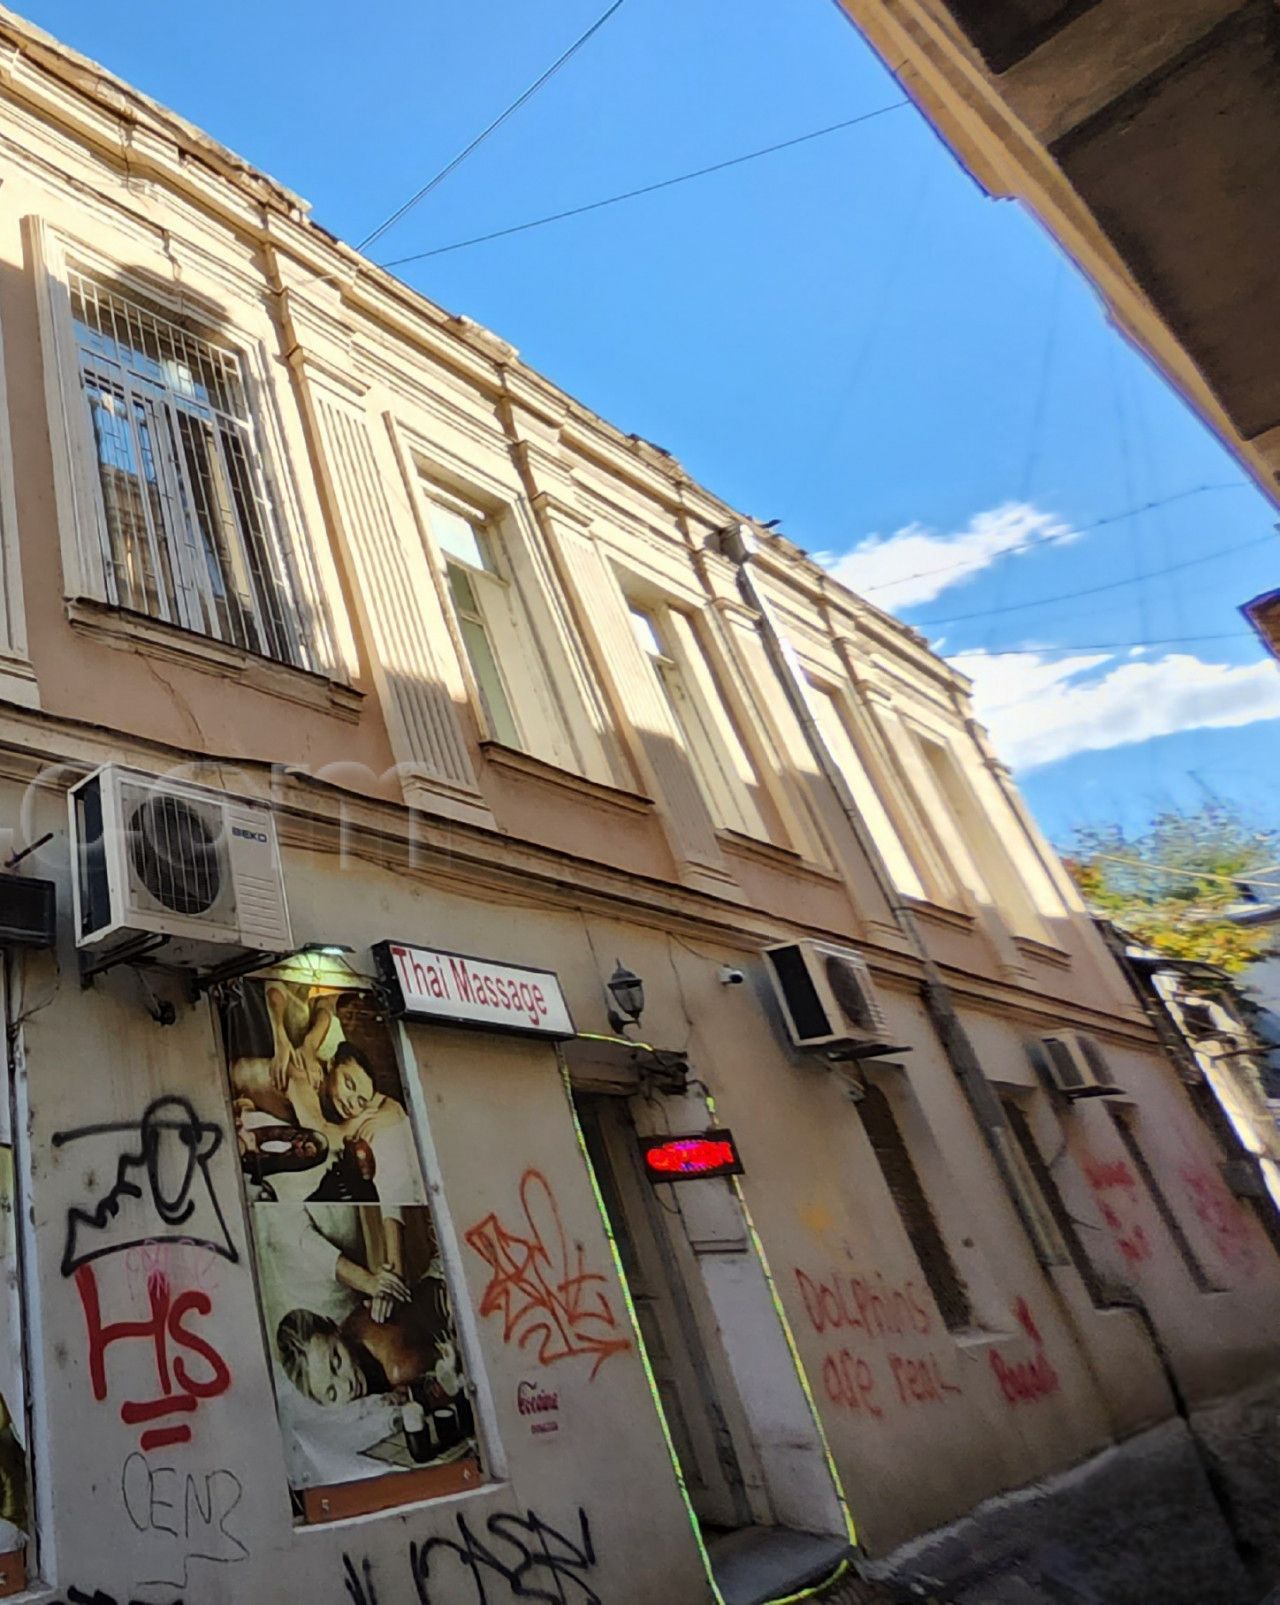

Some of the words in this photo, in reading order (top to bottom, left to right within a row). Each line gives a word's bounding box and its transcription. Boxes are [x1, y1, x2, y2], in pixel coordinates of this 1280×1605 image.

[232, 827, 267, 843] BEKO
[391, 947, 451, 1000] Thai
[449, 958, 548, 1026] Massage
[73, 1261, 232, 1401] HS
